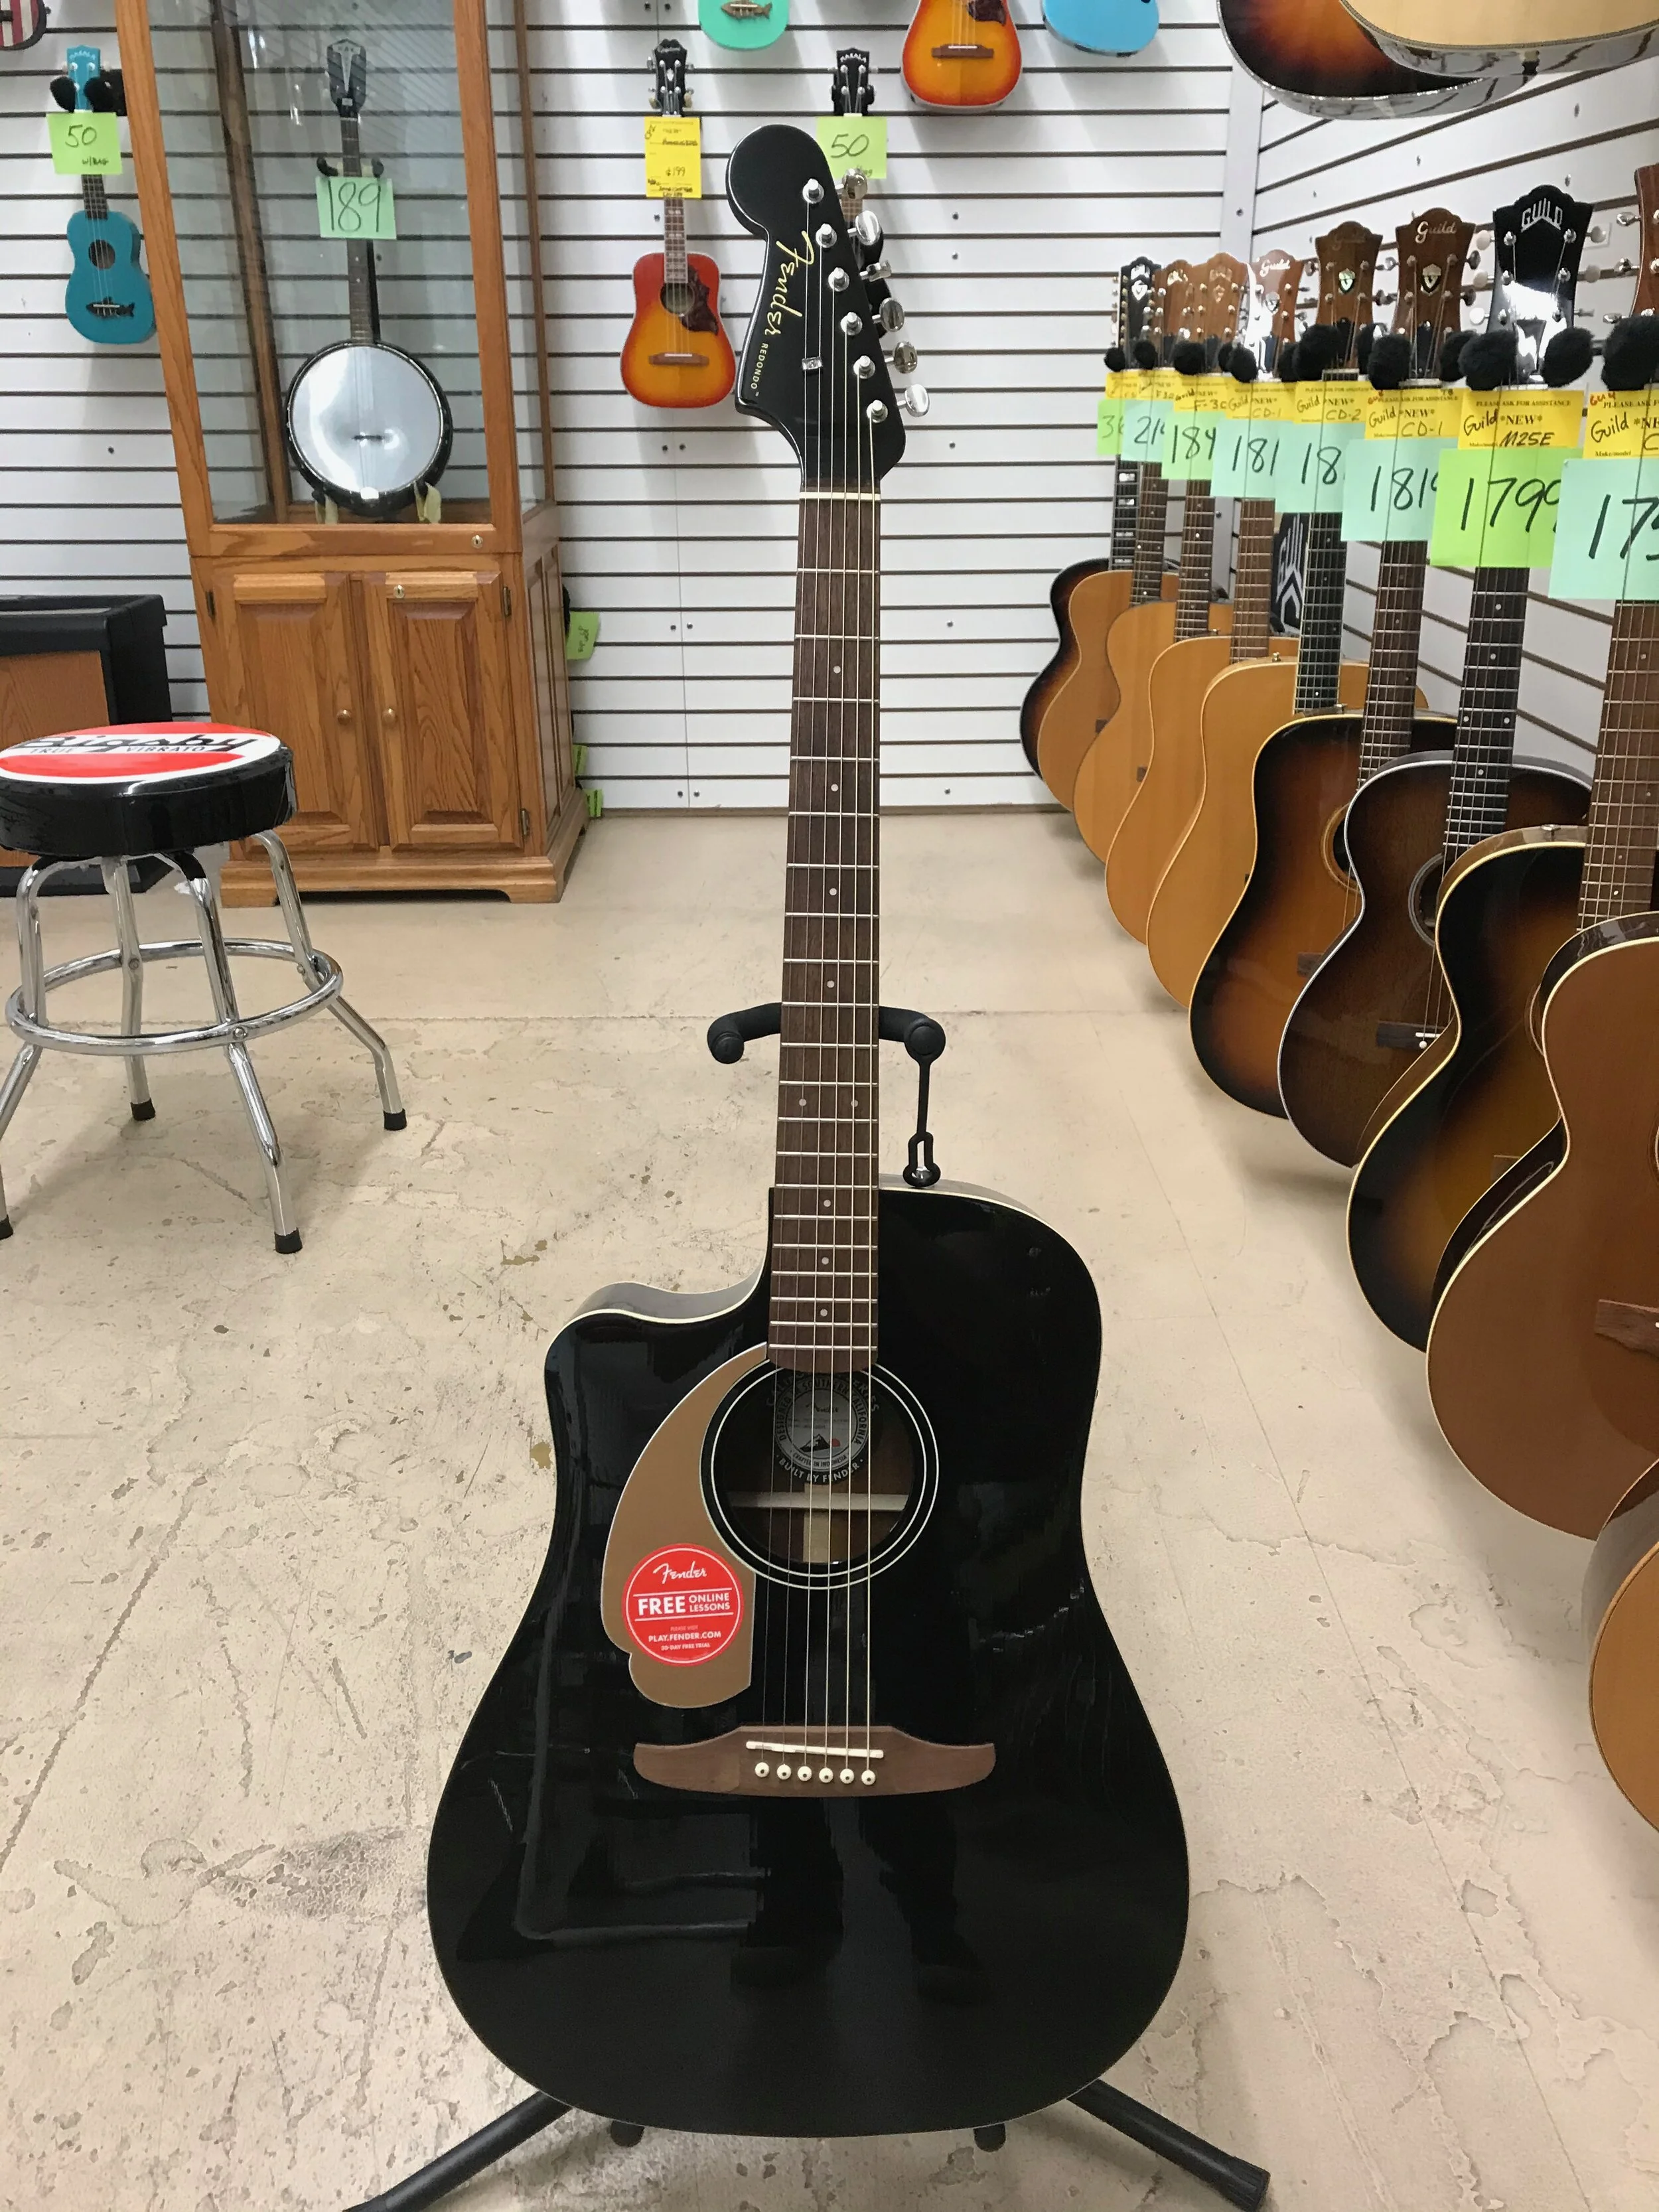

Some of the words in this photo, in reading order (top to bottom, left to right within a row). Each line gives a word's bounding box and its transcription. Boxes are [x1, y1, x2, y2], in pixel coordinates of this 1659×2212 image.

[65, 123, 97, 148] 50
[830, 133, 870, 158] 50
[327, 179, 382, 233] 189
[1521, 198, 1563, 232] GUILD
[1415, 221, 1457, 244] Guild
[764, 230, 815, 336] Fender
[1297, 395, 1321, 413] Guild
[1325, 408, 1362, 421] CD-2
[1368, 406, 1397, 428] Guild
[1401, 420, 1443, 437] CD-1
[1463, 407, 1498, 437] Guild
[1591, 411, 1629, 443] Guild
[1499, 430, 1555, 447] M25E
[1301, 442, 1345, 485] 18
[14, 735, 259, 752] Bigsby
[778, 1457, 804, 1479] BUILT
[806, 1472, 820, 1483] BY
[822, 1461, 861, 1483] FENDER
[652, 1560, 707, 1585] Fender
[638, 1595, 686, 1616] FREE
[688, 1592, 730, 1603] ONLINE
[689, 1601, 731, 1613] LESSONS
[648, 1631, 722, 1643] PLAY.FENDER.COM
